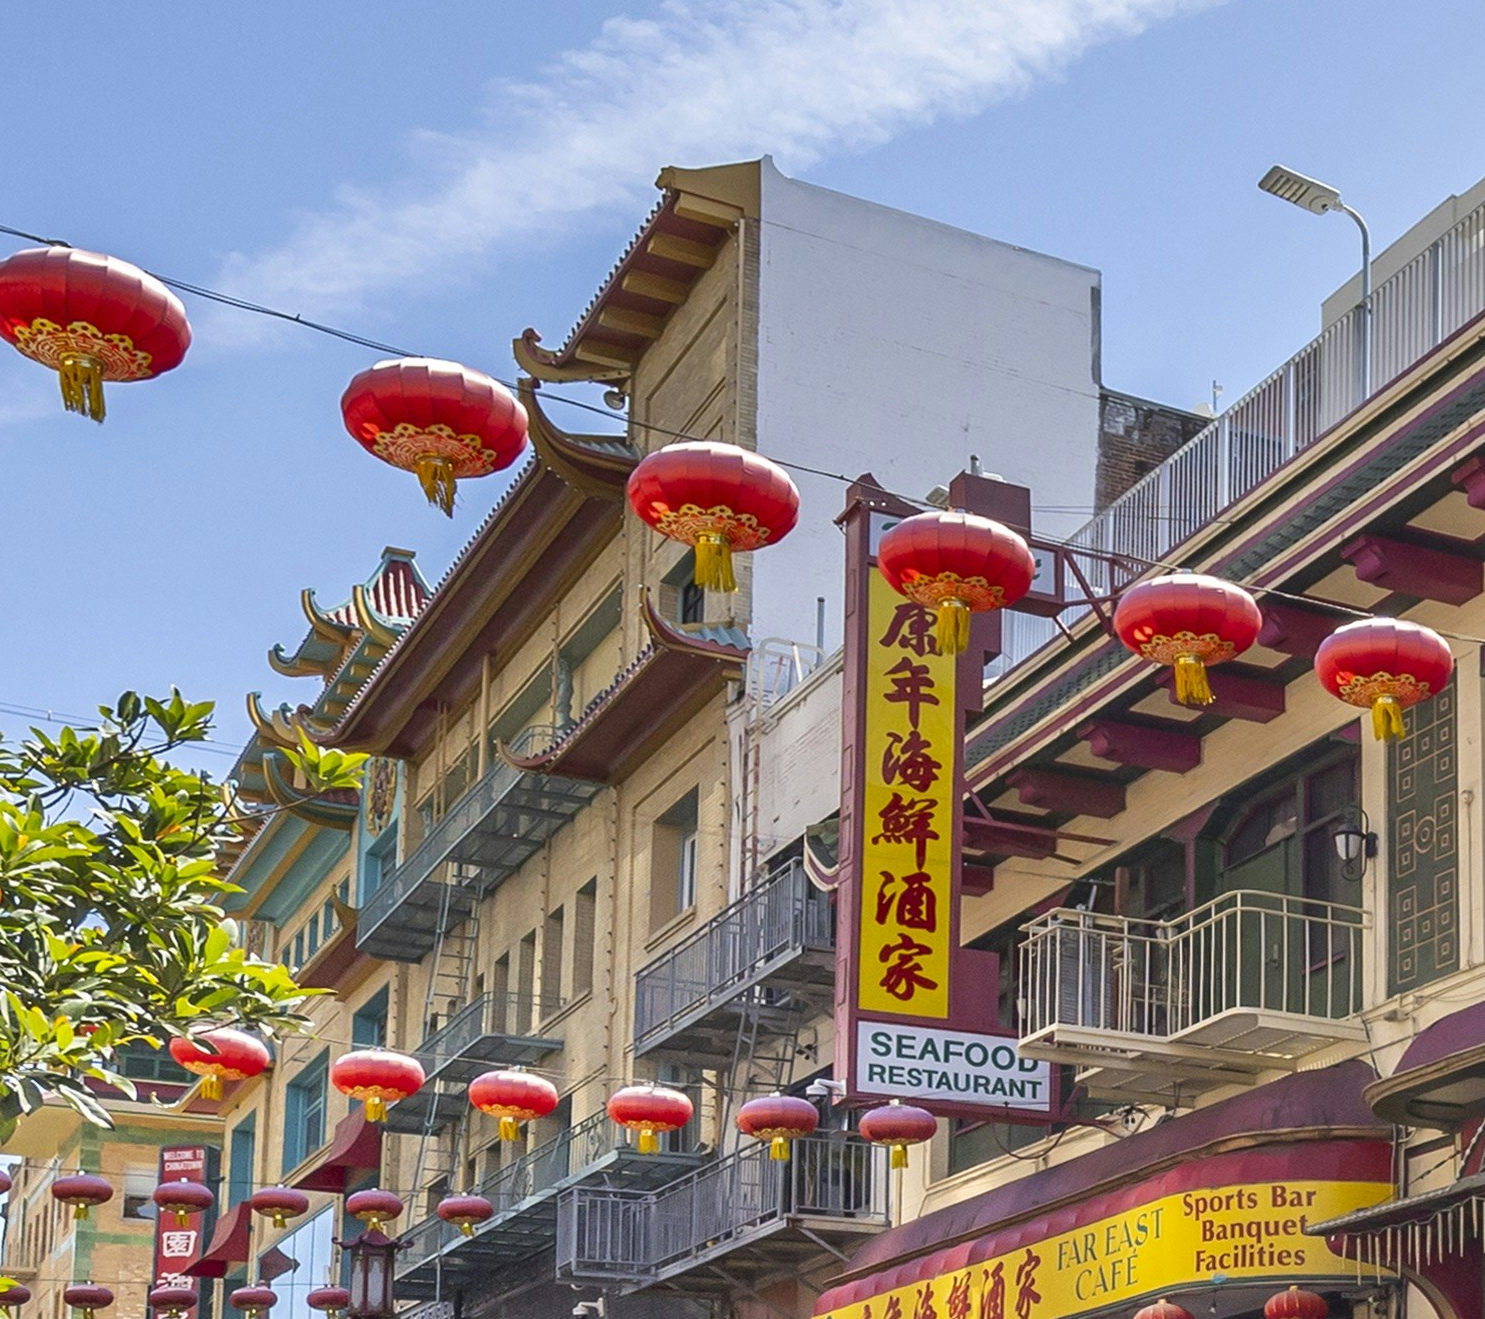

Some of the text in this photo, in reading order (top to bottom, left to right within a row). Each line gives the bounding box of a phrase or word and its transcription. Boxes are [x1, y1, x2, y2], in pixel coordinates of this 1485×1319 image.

[868, 1062, 1043, 1100] RESTAURANT
[1182, 1184, 1318, 1222] Sports Bar
[1055, 1205, 1165, 1272] FAR EAST
[1200, 1213, 1309, 1244] Banquet
[1074, 1247, 1140, 1303] CAFÉ
[1194, 1245, 1306, 1273] Facilities
